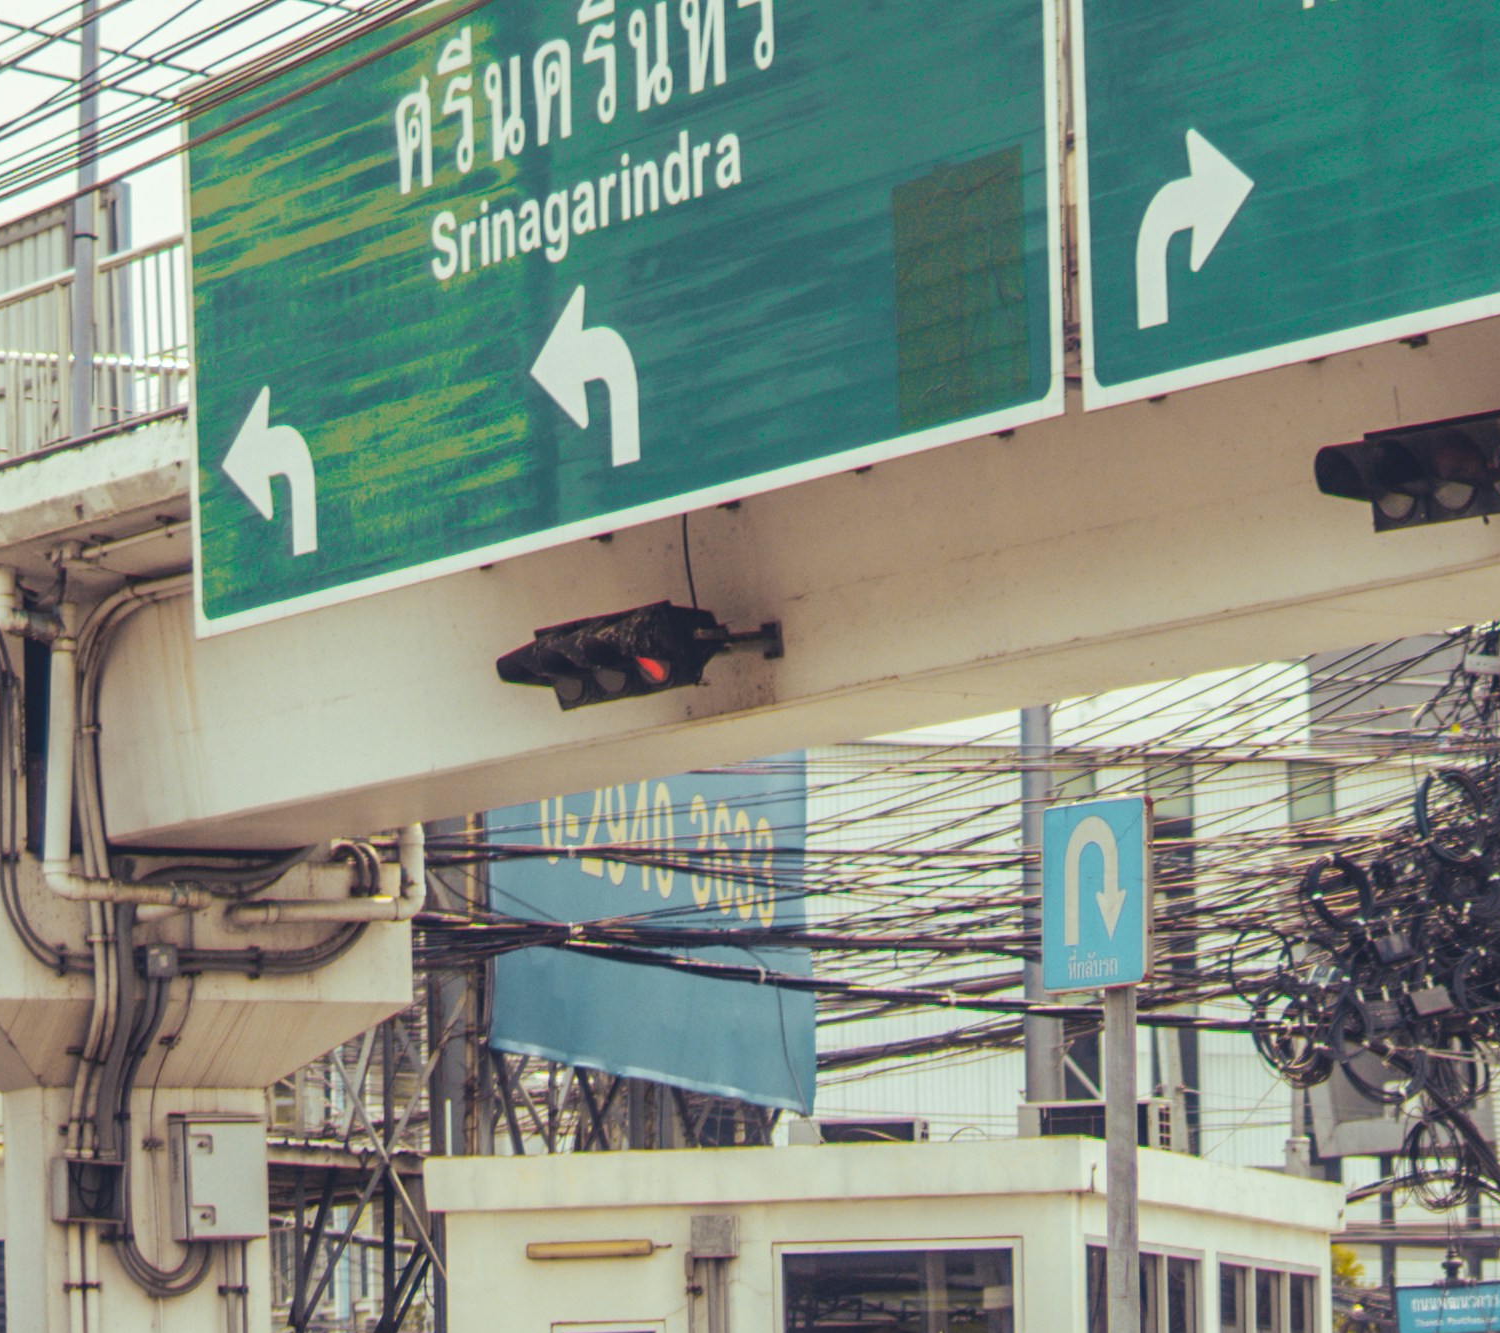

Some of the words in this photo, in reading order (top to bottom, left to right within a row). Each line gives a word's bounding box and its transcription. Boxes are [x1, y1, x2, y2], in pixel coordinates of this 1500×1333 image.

[432, 130, 742, 280] Srinagarindra
[1067, 948, 1119, 980] ที่กลับรถ
